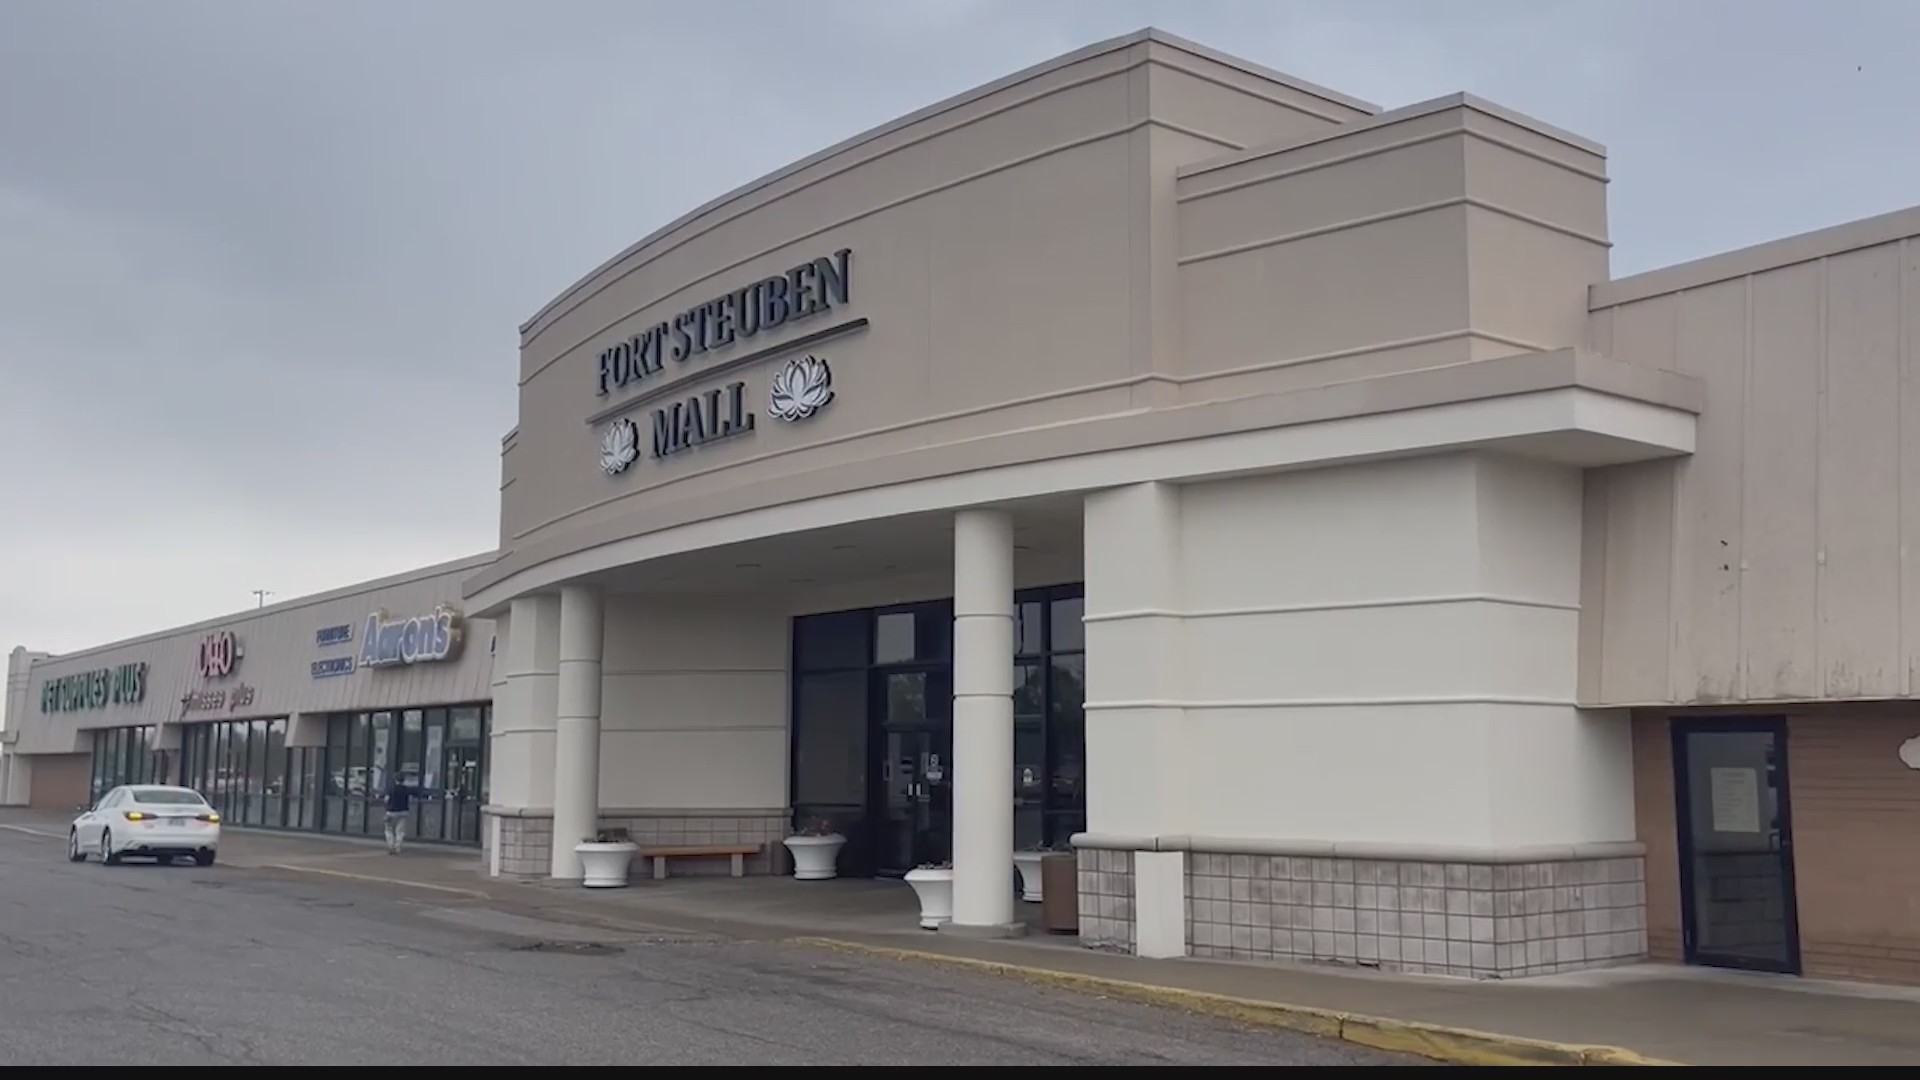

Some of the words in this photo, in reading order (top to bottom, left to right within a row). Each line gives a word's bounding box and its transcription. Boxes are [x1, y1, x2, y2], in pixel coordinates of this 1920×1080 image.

[595, 320, 669, 397] FORT
[671, 248, 852, 363] STEUBEN
[649, 381, 755, 459] MALL
[358, 604, 463, 668] Aaron's
[113, 661, 147, 705] PLUS
